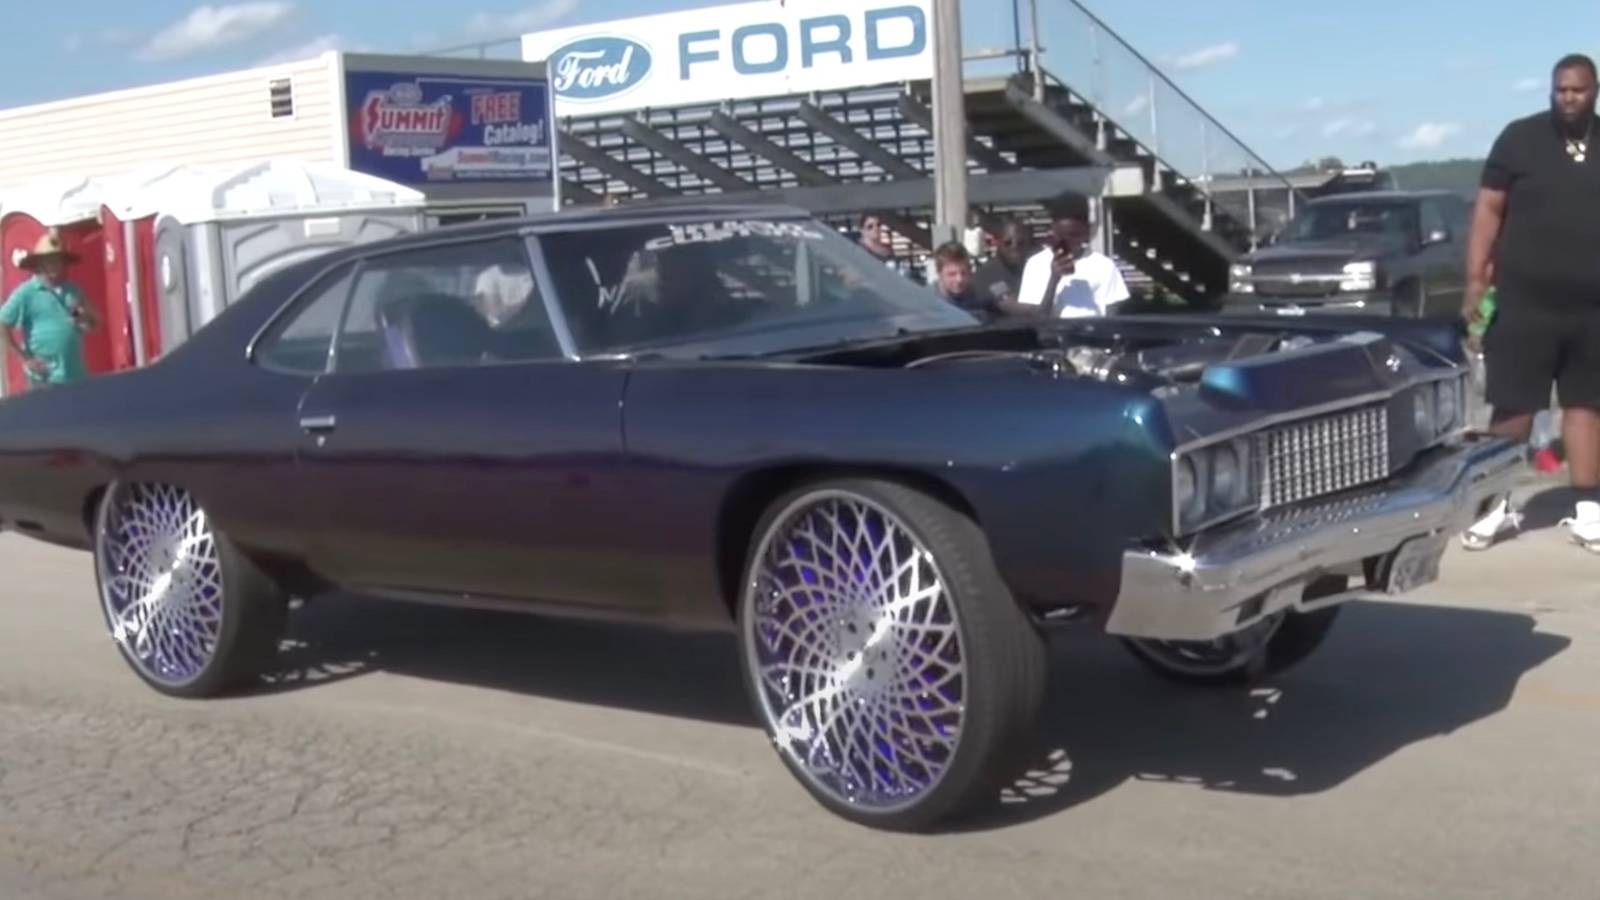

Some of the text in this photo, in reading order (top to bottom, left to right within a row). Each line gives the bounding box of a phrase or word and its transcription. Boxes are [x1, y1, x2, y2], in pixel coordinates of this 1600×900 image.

[679, 5, 927, 81] FORD
[553, 46, 631, 91] Ford
[471, 92, 522, 125] FREE
[484, 118, 544, 145] Catalog!
